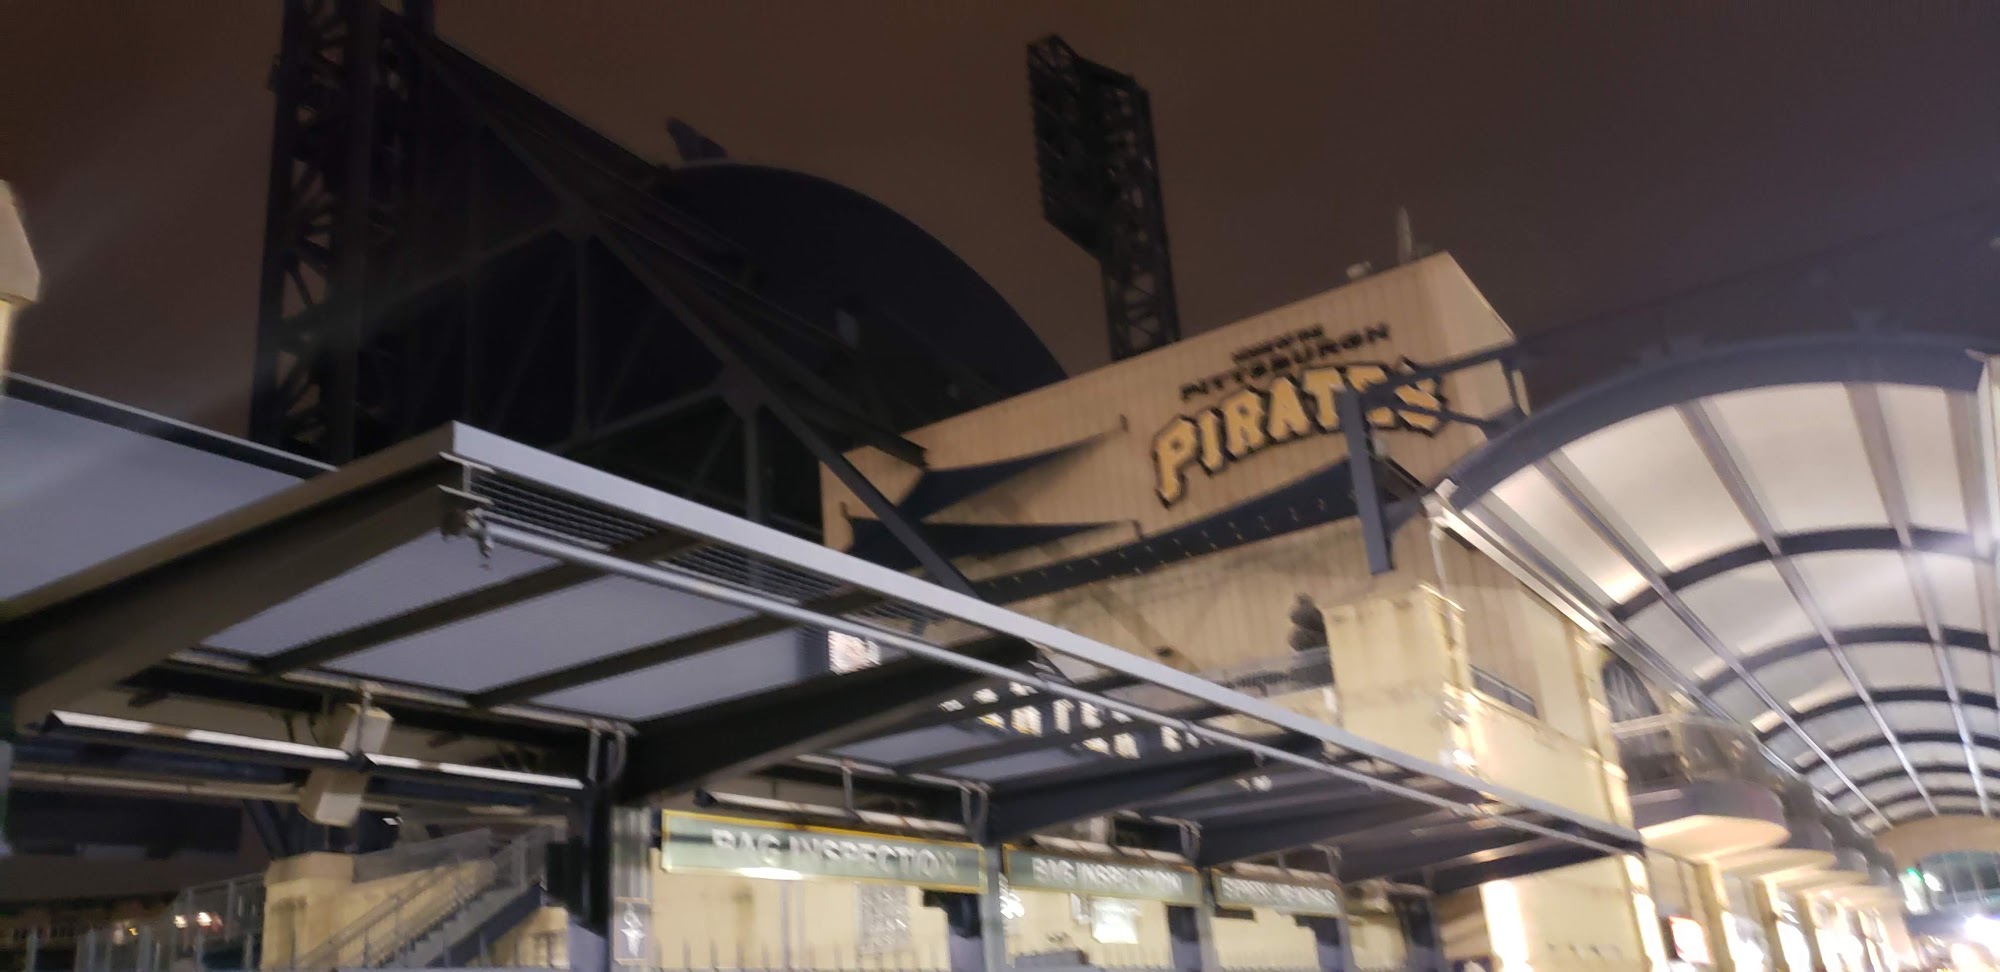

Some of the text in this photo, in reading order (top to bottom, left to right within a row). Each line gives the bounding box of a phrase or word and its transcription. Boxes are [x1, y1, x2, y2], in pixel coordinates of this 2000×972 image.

[711, 828, 959, 881] BAG INSPECTION
[1031, 857, 1077, 887] BAG
